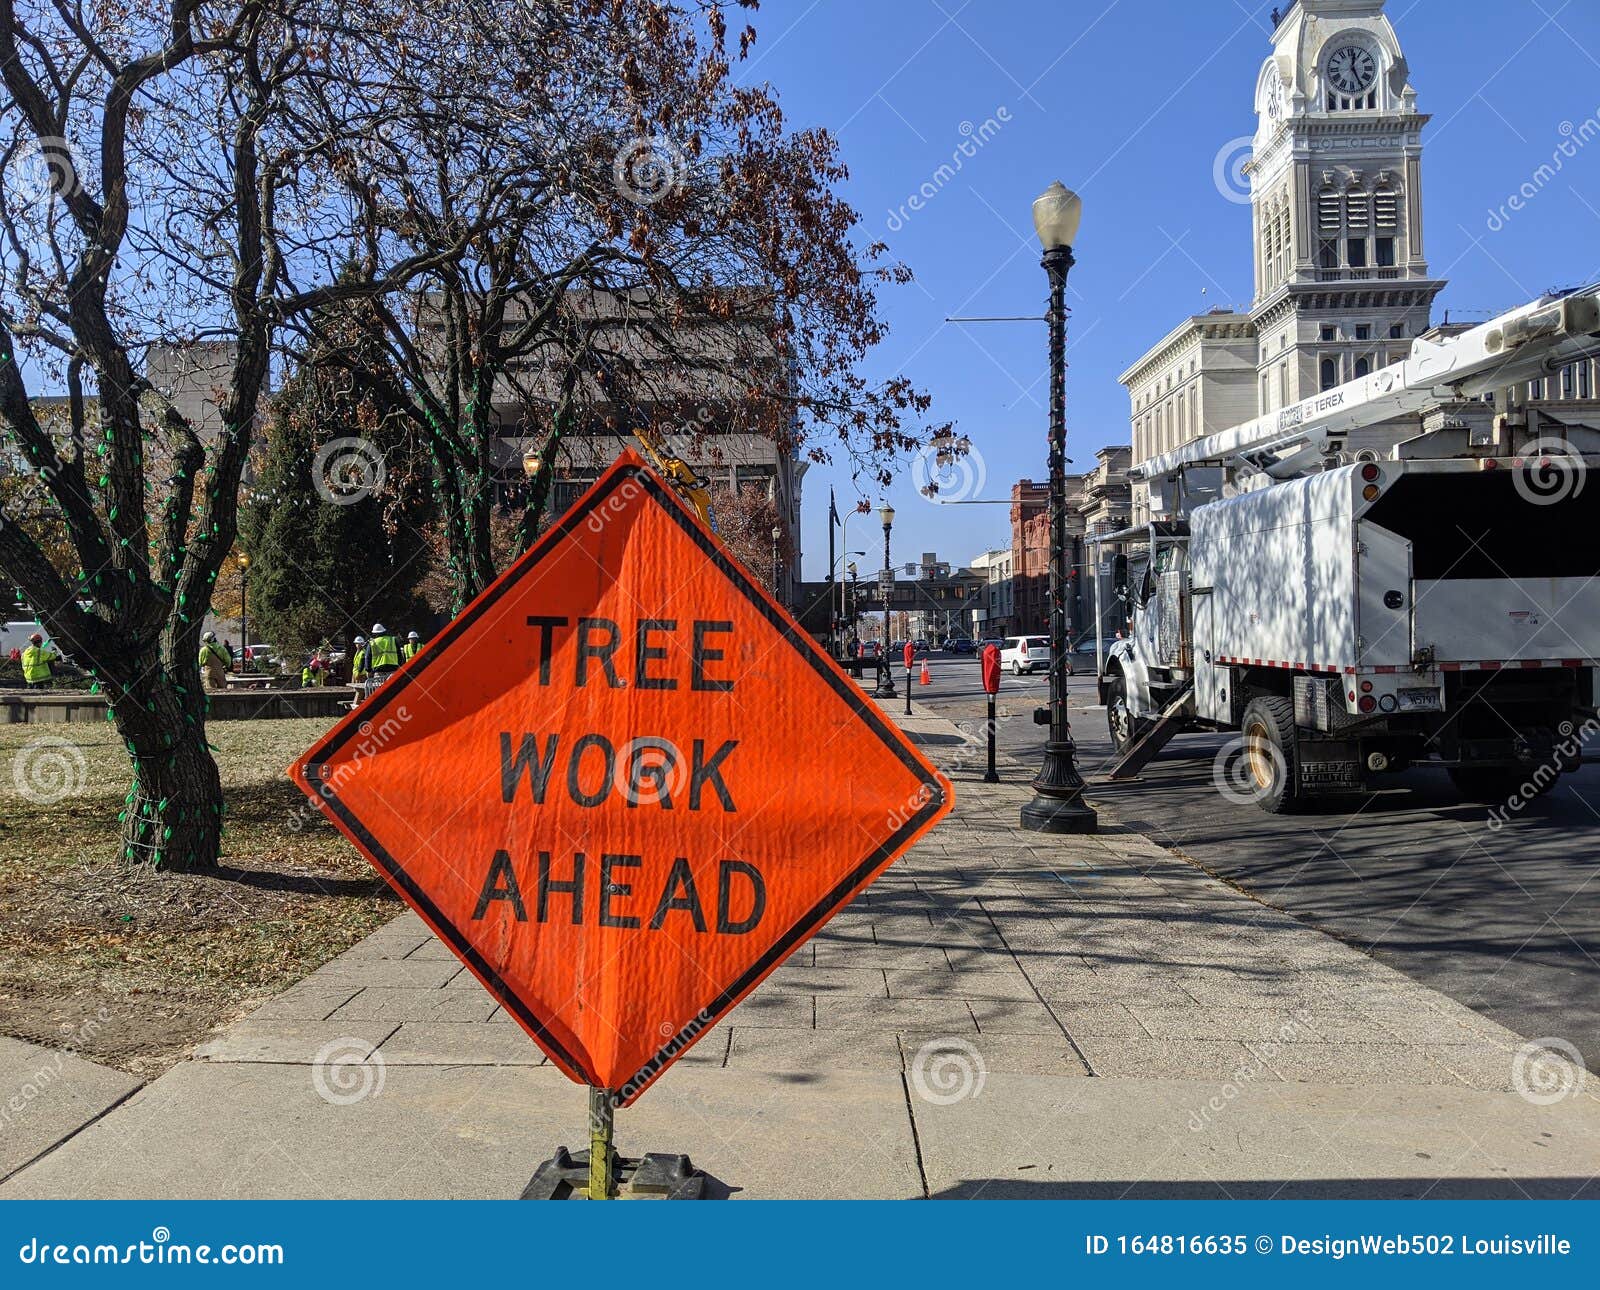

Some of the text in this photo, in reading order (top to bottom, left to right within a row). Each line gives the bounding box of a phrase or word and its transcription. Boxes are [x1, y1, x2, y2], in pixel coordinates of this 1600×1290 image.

[1314, 392, 1344, 412] TEREX
[526, 615, 735, 692] TREE
[500, 732, 740, 813] WORK
[471, 849, 766, 935] AHEAD
